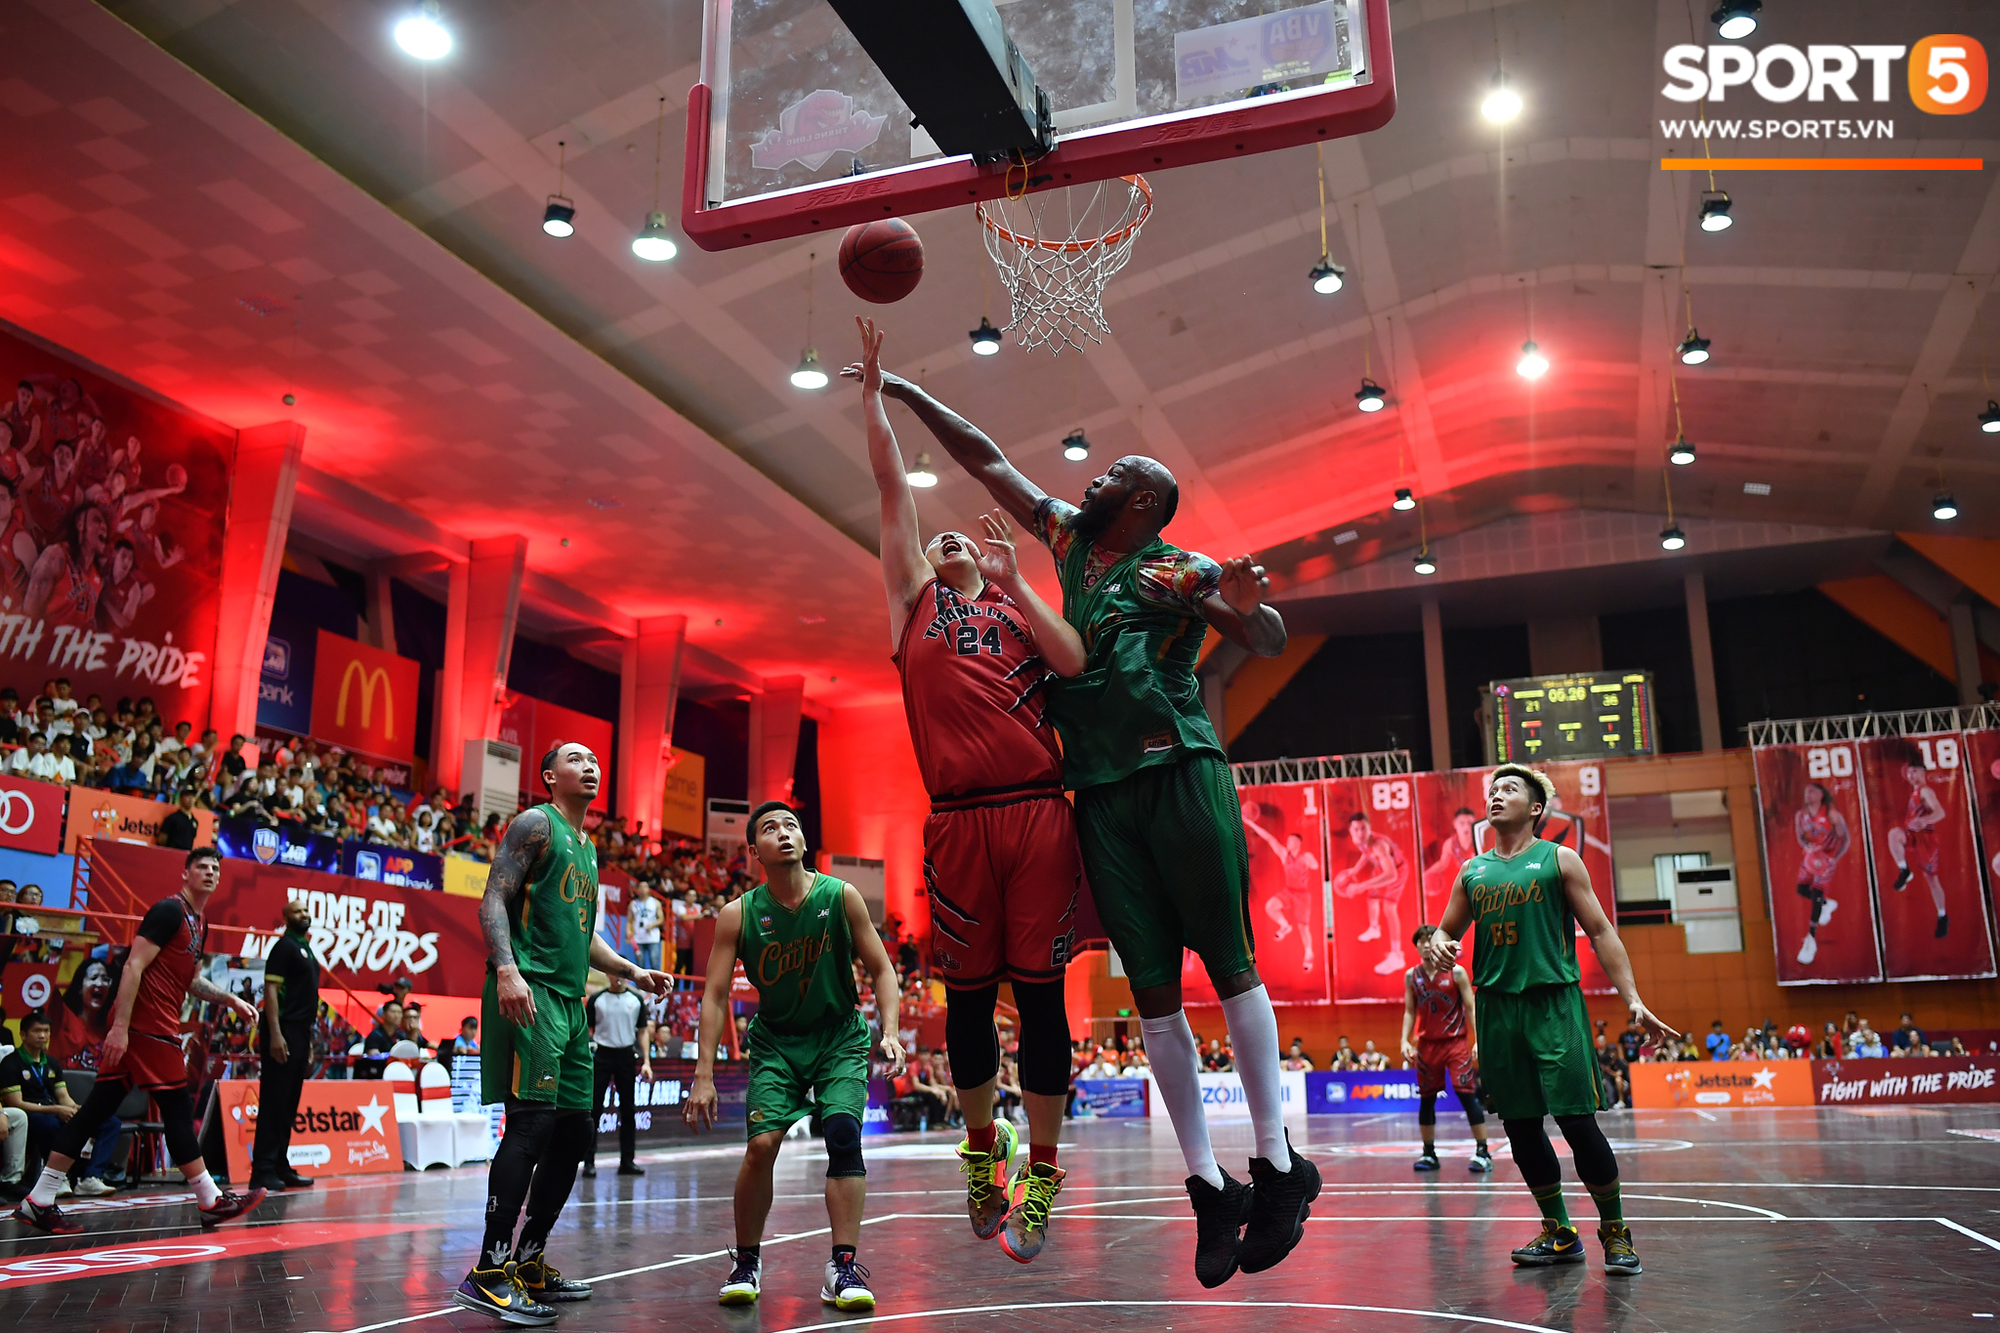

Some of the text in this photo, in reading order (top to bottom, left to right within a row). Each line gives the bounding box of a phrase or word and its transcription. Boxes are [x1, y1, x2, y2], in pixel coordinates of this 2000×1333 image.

[923, 603, 982, 639] THANG
[48, 625, 114, 672] THE
[115, 631, 205, 689] PRIDE
[956, 626, 1002, 656] 24
[1807, 746, 1853, 779] 20
[1918, 738, 1959, 770] 18
[1303, 786, 1317, 815] 1
[1372, 780, 1410, 811] 83
[119, 817, 158, 837] Jetst
[385, 856, 414, 874] APP
[368, 900, 405, 932] OF
[1472, 879, 1544, 924] Catfish
[240, 925, 440, 974] WRRIORS
[758, 928, 832, 986] Catfih
[1695, 1074, 1754, 1088] Jetstar
[1821, 1063, 1996, 1102] FIGHT WITH THE PRIDE
[292, 1106, 360, 1133] etstar
